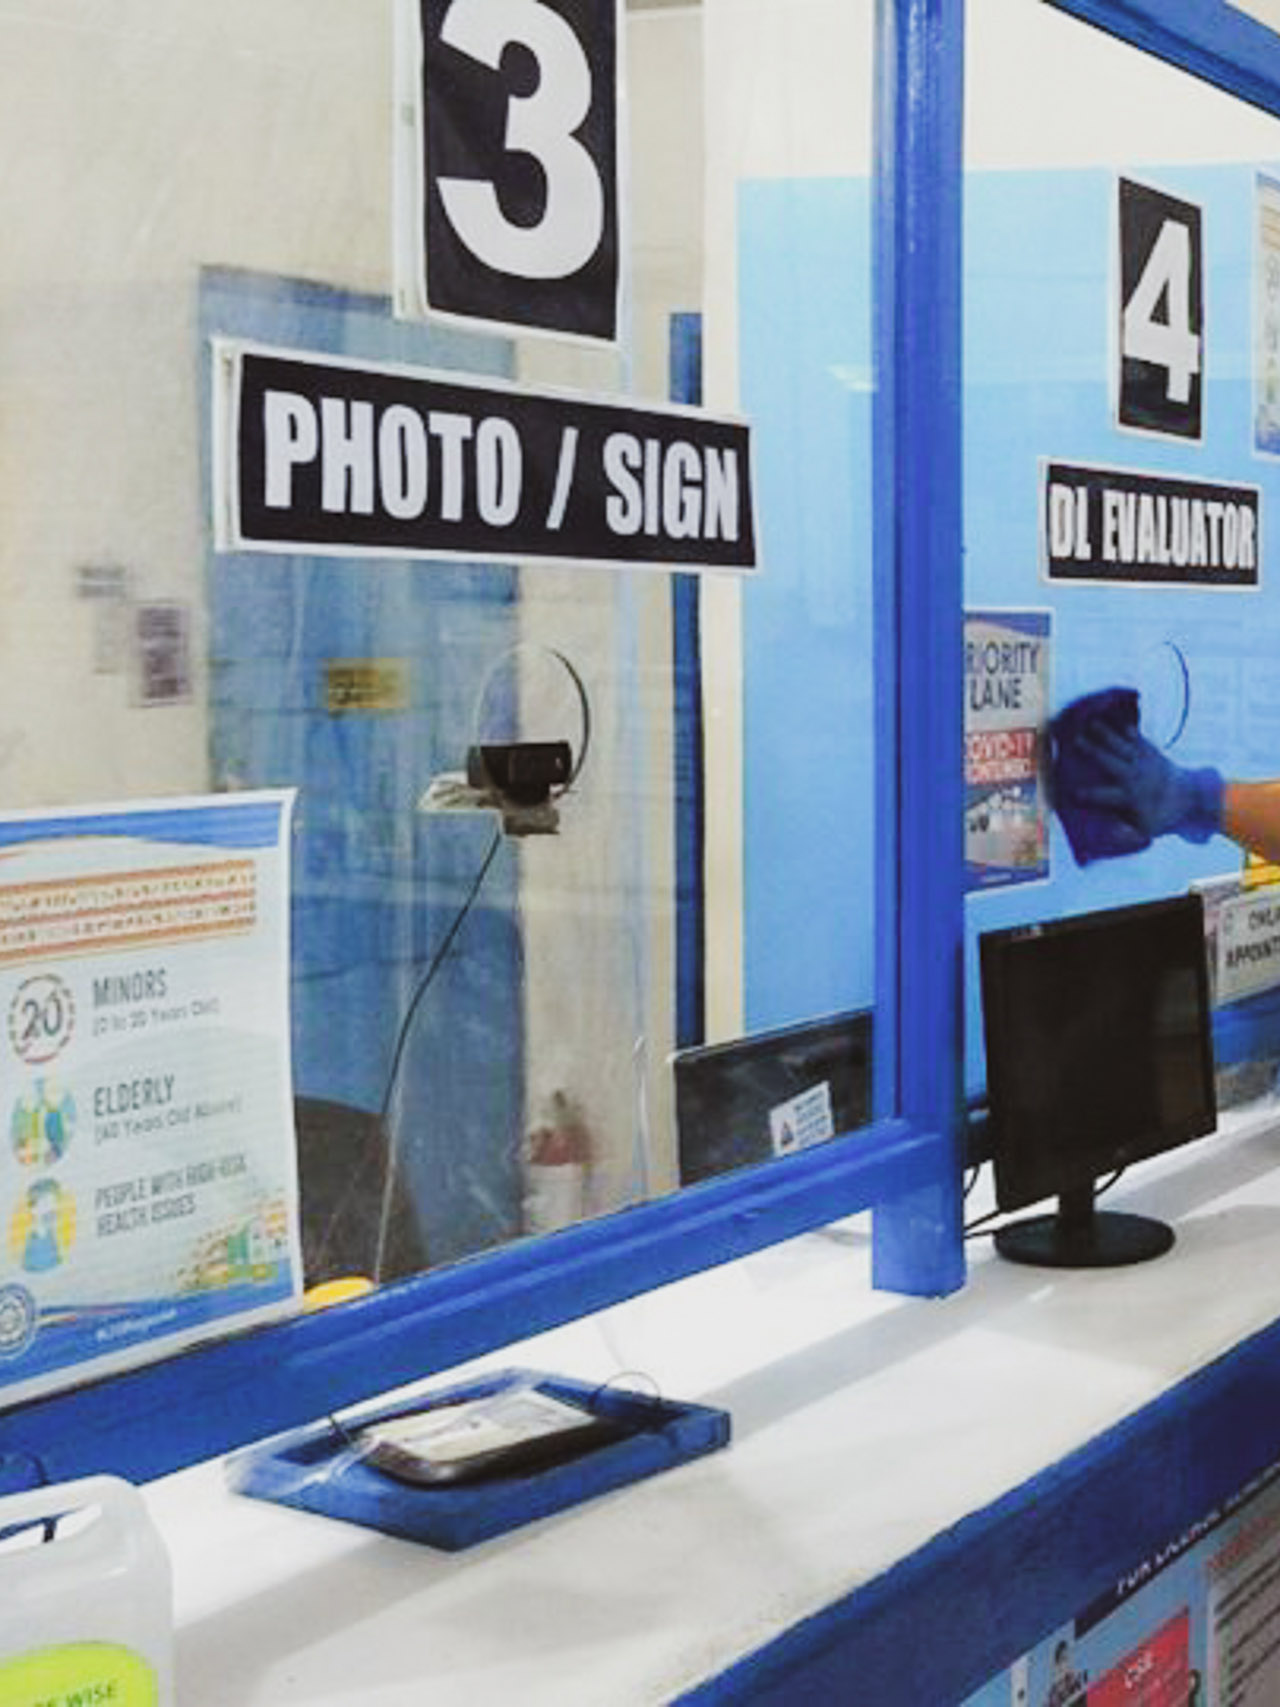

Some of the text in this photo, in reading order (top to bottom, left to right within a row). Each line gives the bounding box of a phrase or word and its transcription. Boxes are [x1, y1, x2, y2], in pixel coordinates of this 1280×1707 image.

[436, 0, 603, 280] 3
[1123, 218, 1201, 404] 4
[263, 390, 739, 542] PHOTO / SIGN
[1049, 483, 1256, 571] DL EVALUATOR
[966, 640, 1040, 676] RIORITY
[970, 677, 1022, 711] LANE
[93, 967, 168, 1010] MINORS
[20, 992, 63, 1041] 20
[94, 1074, 175, 1118] ELDERLY
[95, 1177, 146, 1210] PEOPLE
[151, 1168, 184, 1196] WITH
[97, 1192, 197, 1238] HEALTH ISSUES
